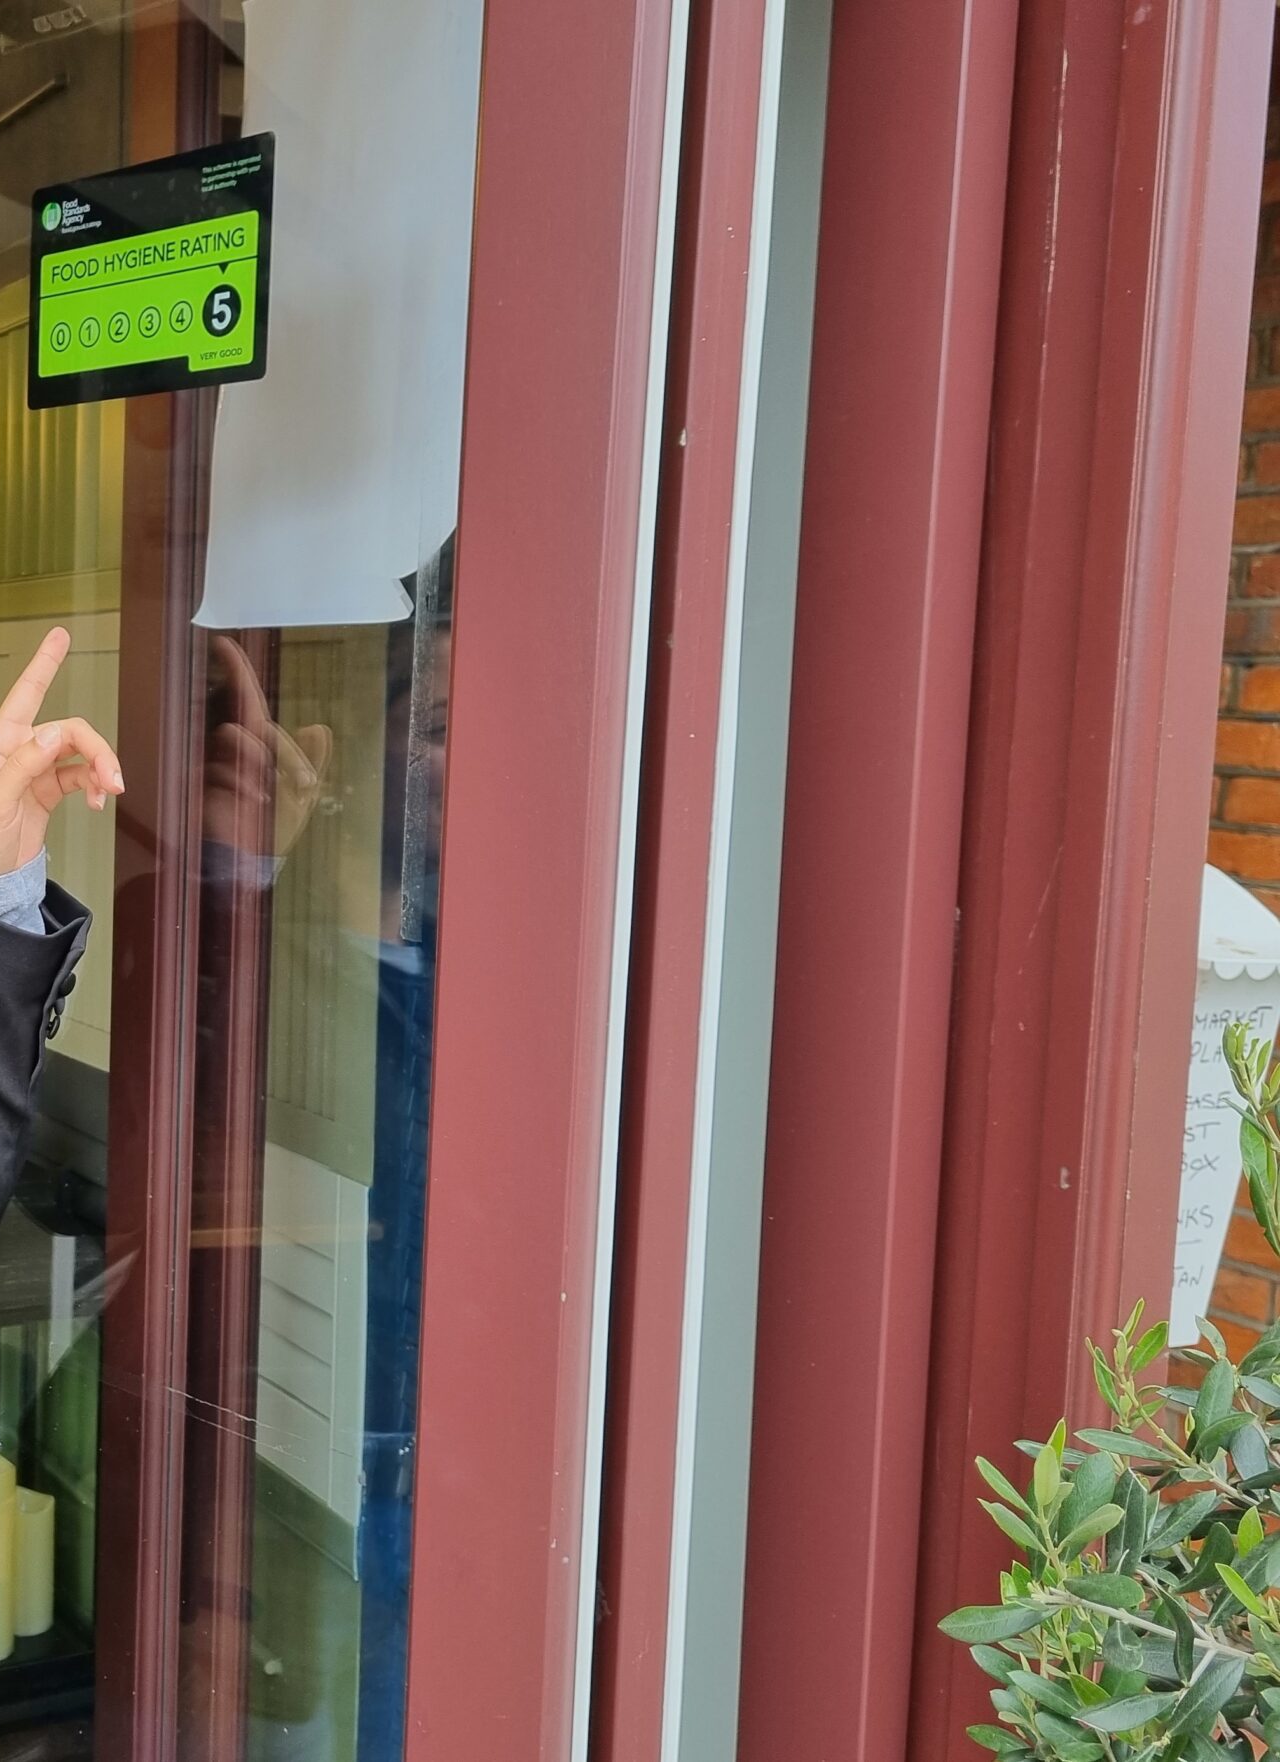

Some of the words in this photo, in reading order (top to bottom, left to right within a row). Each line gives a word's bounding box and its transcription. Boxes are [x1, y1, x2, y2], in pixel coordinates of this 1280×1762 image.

[62, 198, 79, 210] Food
[62, 204, 91, 218] Standards
[61, 214, 85, 227] Agency
[51, 258, 99, 284] FOOD
[104, 241, 176, 274] HYGIENE
[180, 227, 245, 258] RATING
[56, 332, 66, 346] 0
[85, 324, 93, 342] 1
[114, 318, 125, 336] 2
[145, 313, 155, 332] 3
[175, 307, 186, 326] 4
[211, 290, 233, 331] 5
[200, 351, 218, 361] VERY
[219, 347, 243, 358] GOOD
[1184, 1121, 1222, 1142] ST
